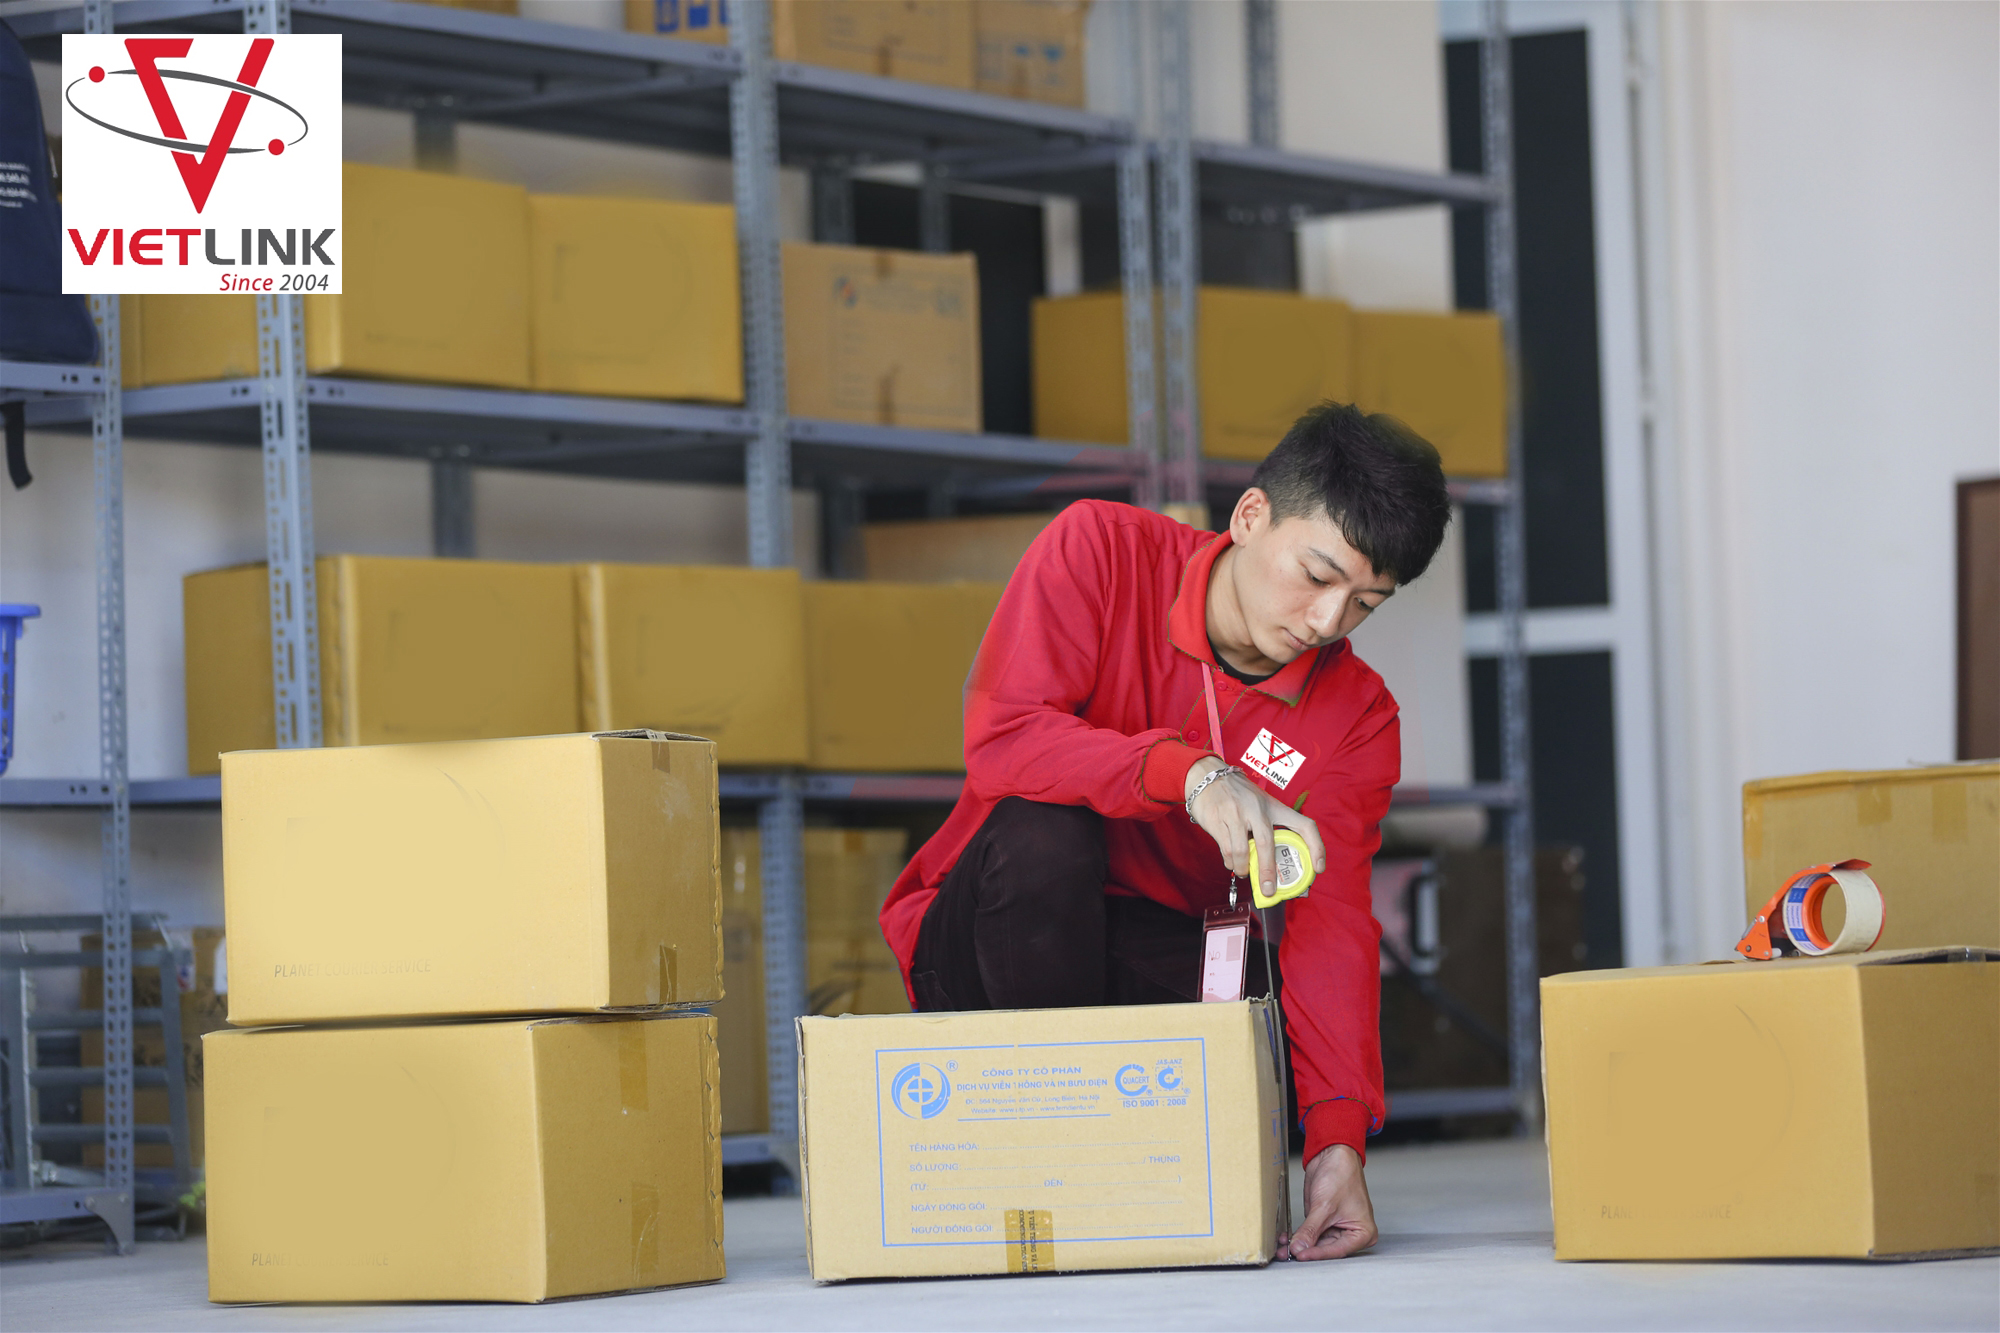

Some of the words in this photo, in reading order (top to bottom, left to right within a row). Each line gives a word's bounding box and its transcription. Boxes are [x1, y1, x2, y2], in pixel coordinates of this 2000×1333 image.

[1245, 752, 1289, 786] VIETLINK
[274, 963, 321, 978] PLANET
[981, 1067, 1014, 1078] CÔNG
[1017, 1067, 1030, 1076] TY
[1122, 1075, 1150, 1084] QUACERT
[1122, 1099, 1138, 1108] ISO
[1139, 1099, 1159, 1107] 9001
[1167, 1098, 1187, 1106] 2008
